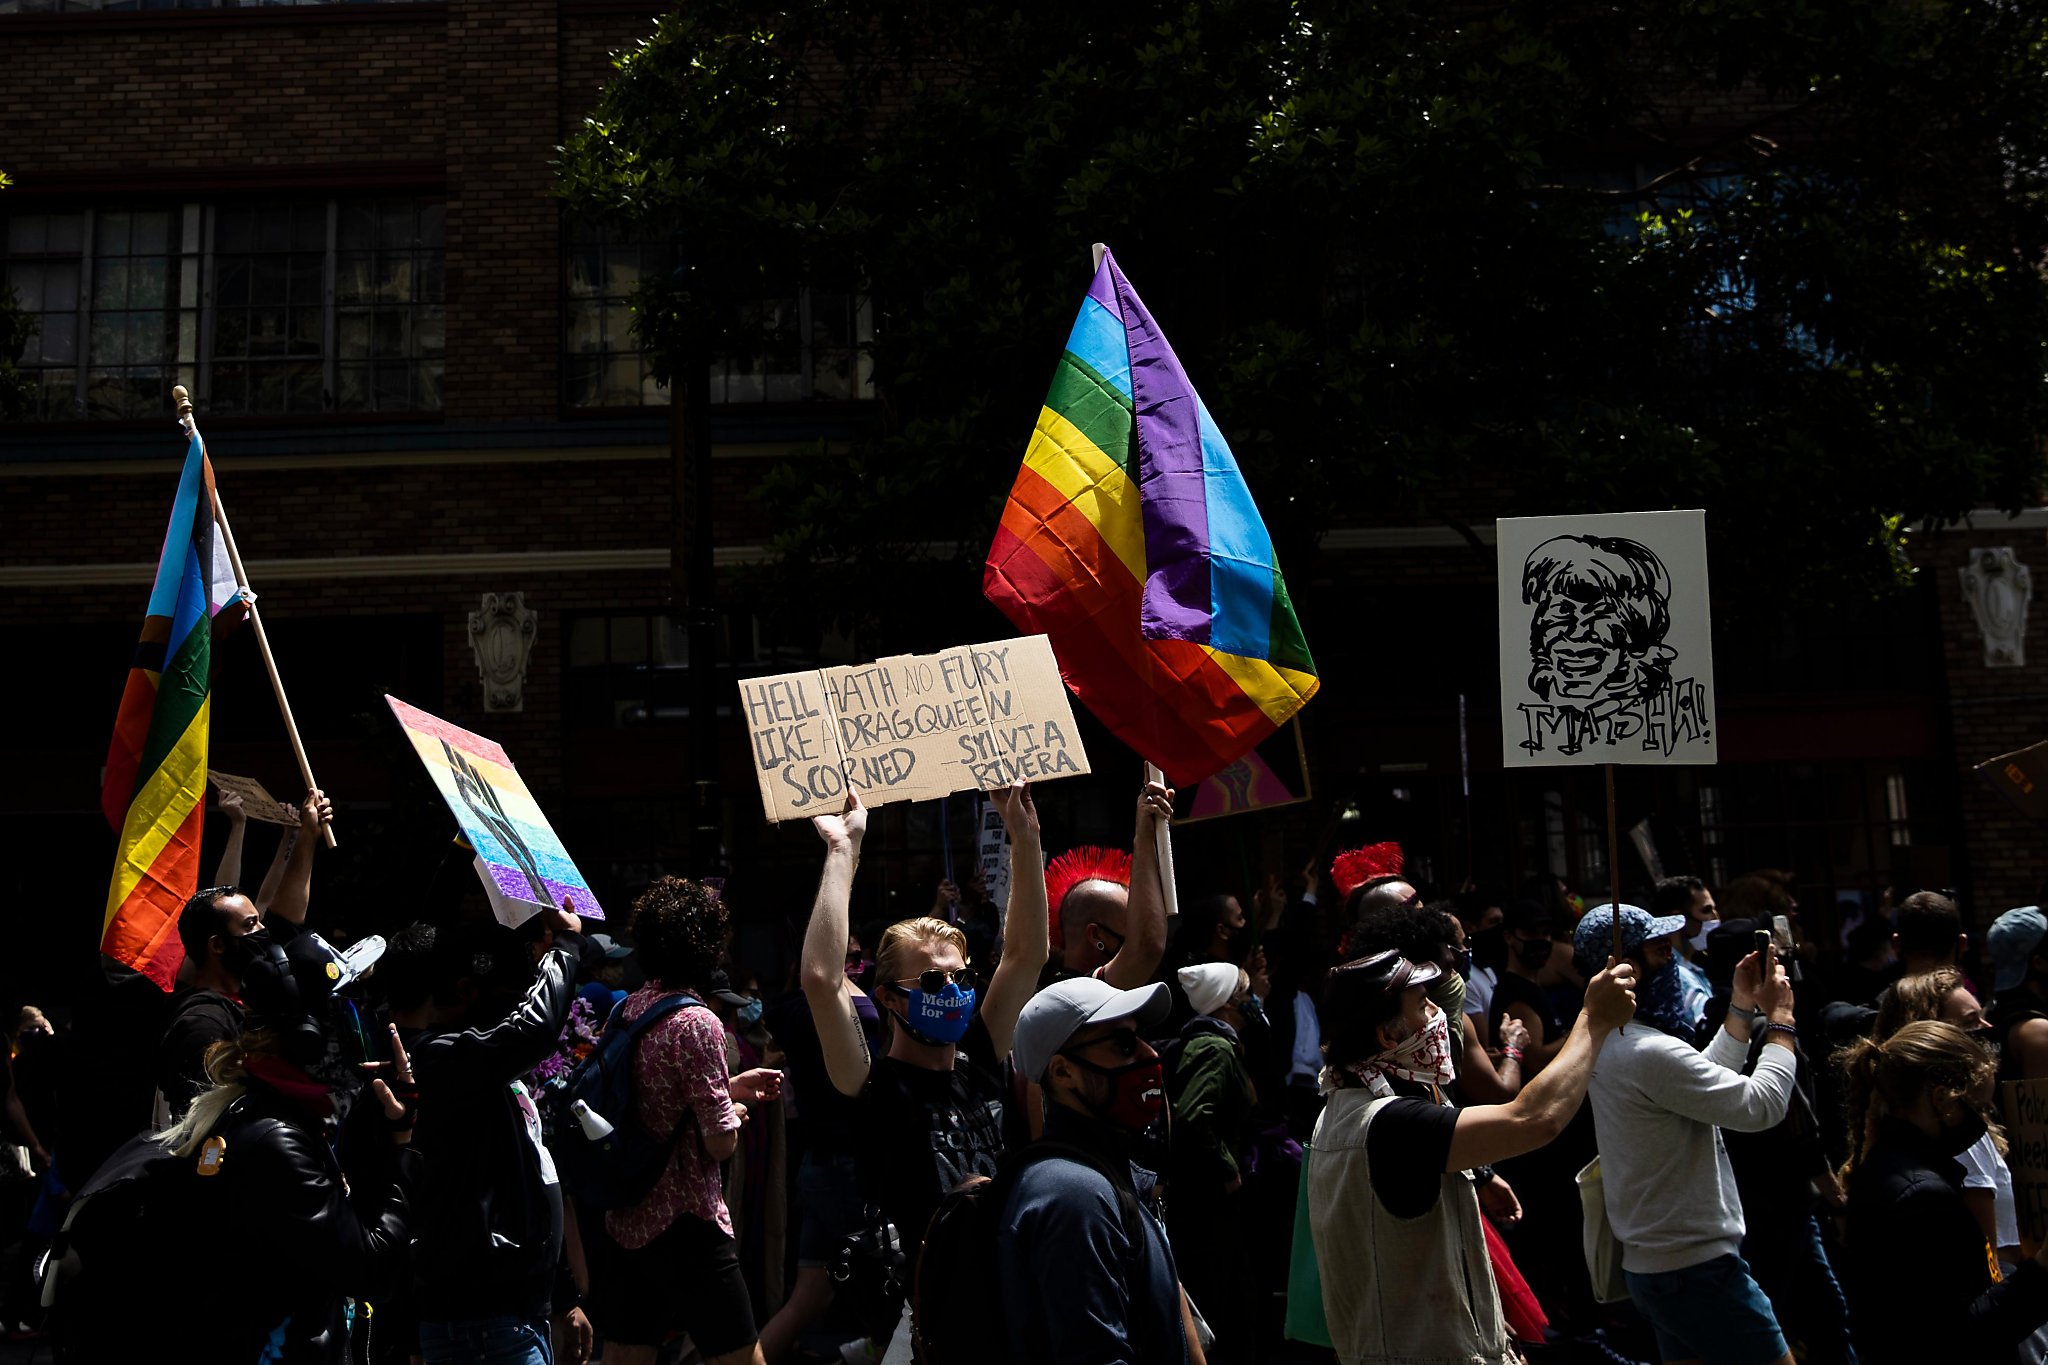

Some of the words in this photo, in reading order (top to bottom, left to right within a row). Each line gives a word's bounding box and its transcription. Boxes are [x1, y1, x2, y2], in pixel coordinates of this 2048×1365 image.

[745, 680, 820, 725] HELL
[824, 667, 899, 713] HATH
[905, 663, 934, 698] NO
[938, 647, 1010, 694] FURY
[753, 722, 819, 770] LIKE
[821, 718, 836, 754] A
[968, 748, 1081, 791] RIVERA
[782, 746, 916, 808] SCORNED
[921, 1004, 944, 1019] for
